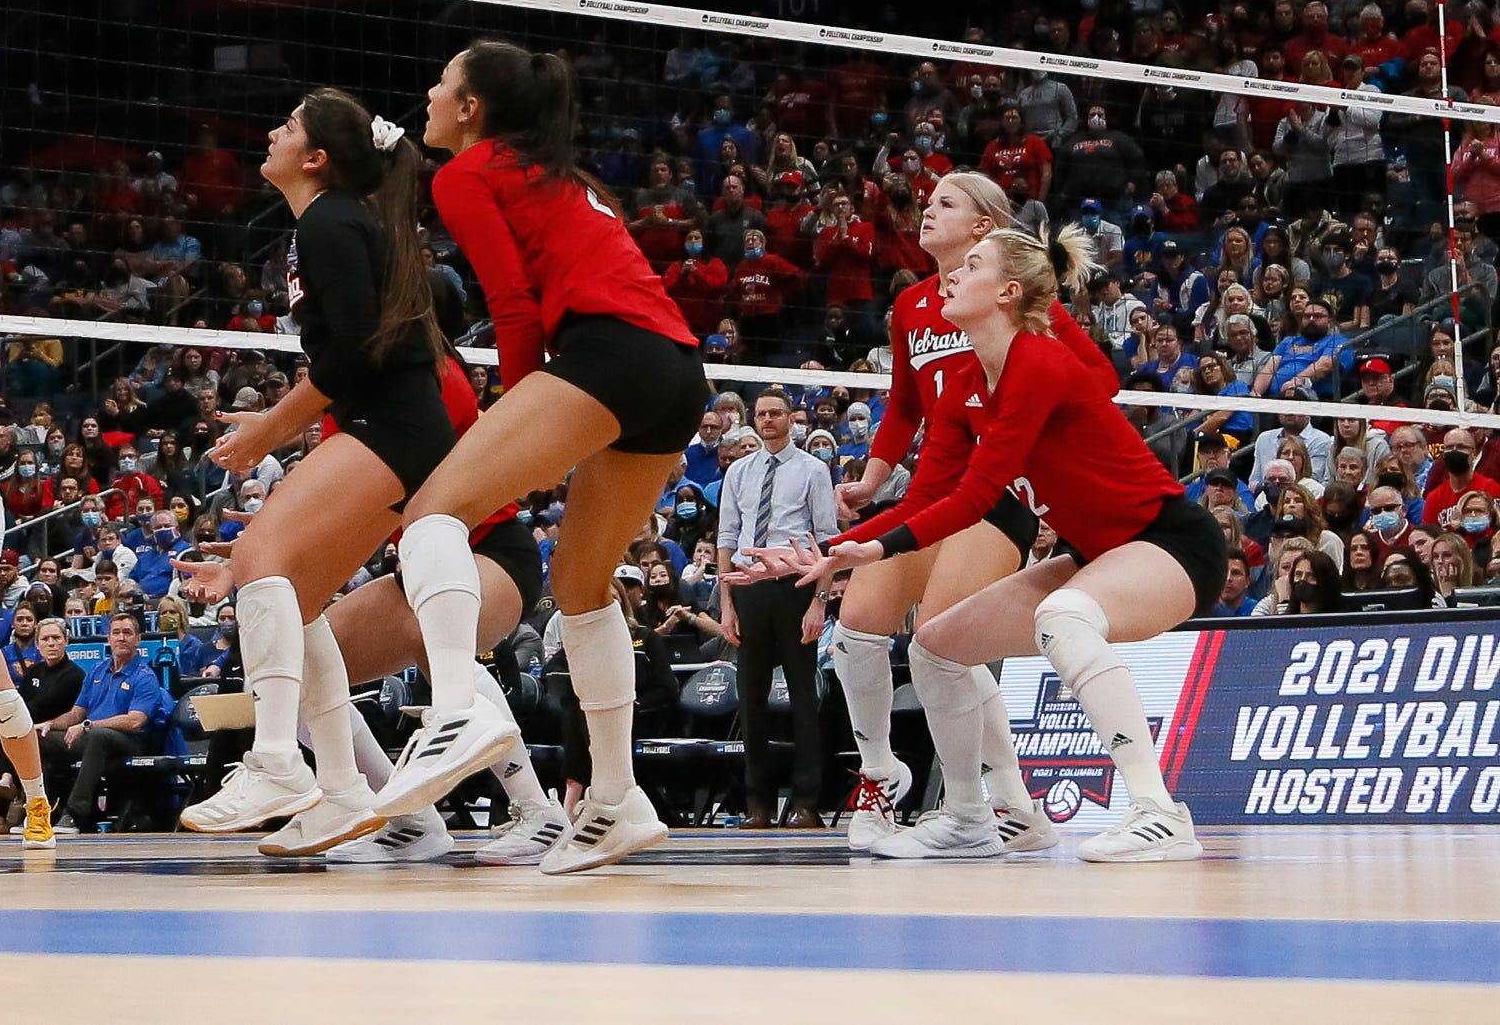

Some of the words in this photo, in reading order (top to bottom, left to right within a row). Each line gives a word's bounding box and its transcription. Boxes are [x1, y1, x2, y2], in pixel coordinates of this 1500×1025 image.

[908, 327, 973, 355] Nebrask
[934, 370, 945, 398] 1
[1278, 637, 1410, 696] 2021
[1413, 634, 1500, 693] DIV
[1230, 700, 1500, 762] VOLLEYBAL
[1033, 768, 1053, 776] 2021
[1059, 768, 1103, 777] COLUMBUS
[1244, 767, 1404, 814] HOSTED
[1405, 766, 1469, 814] BY
